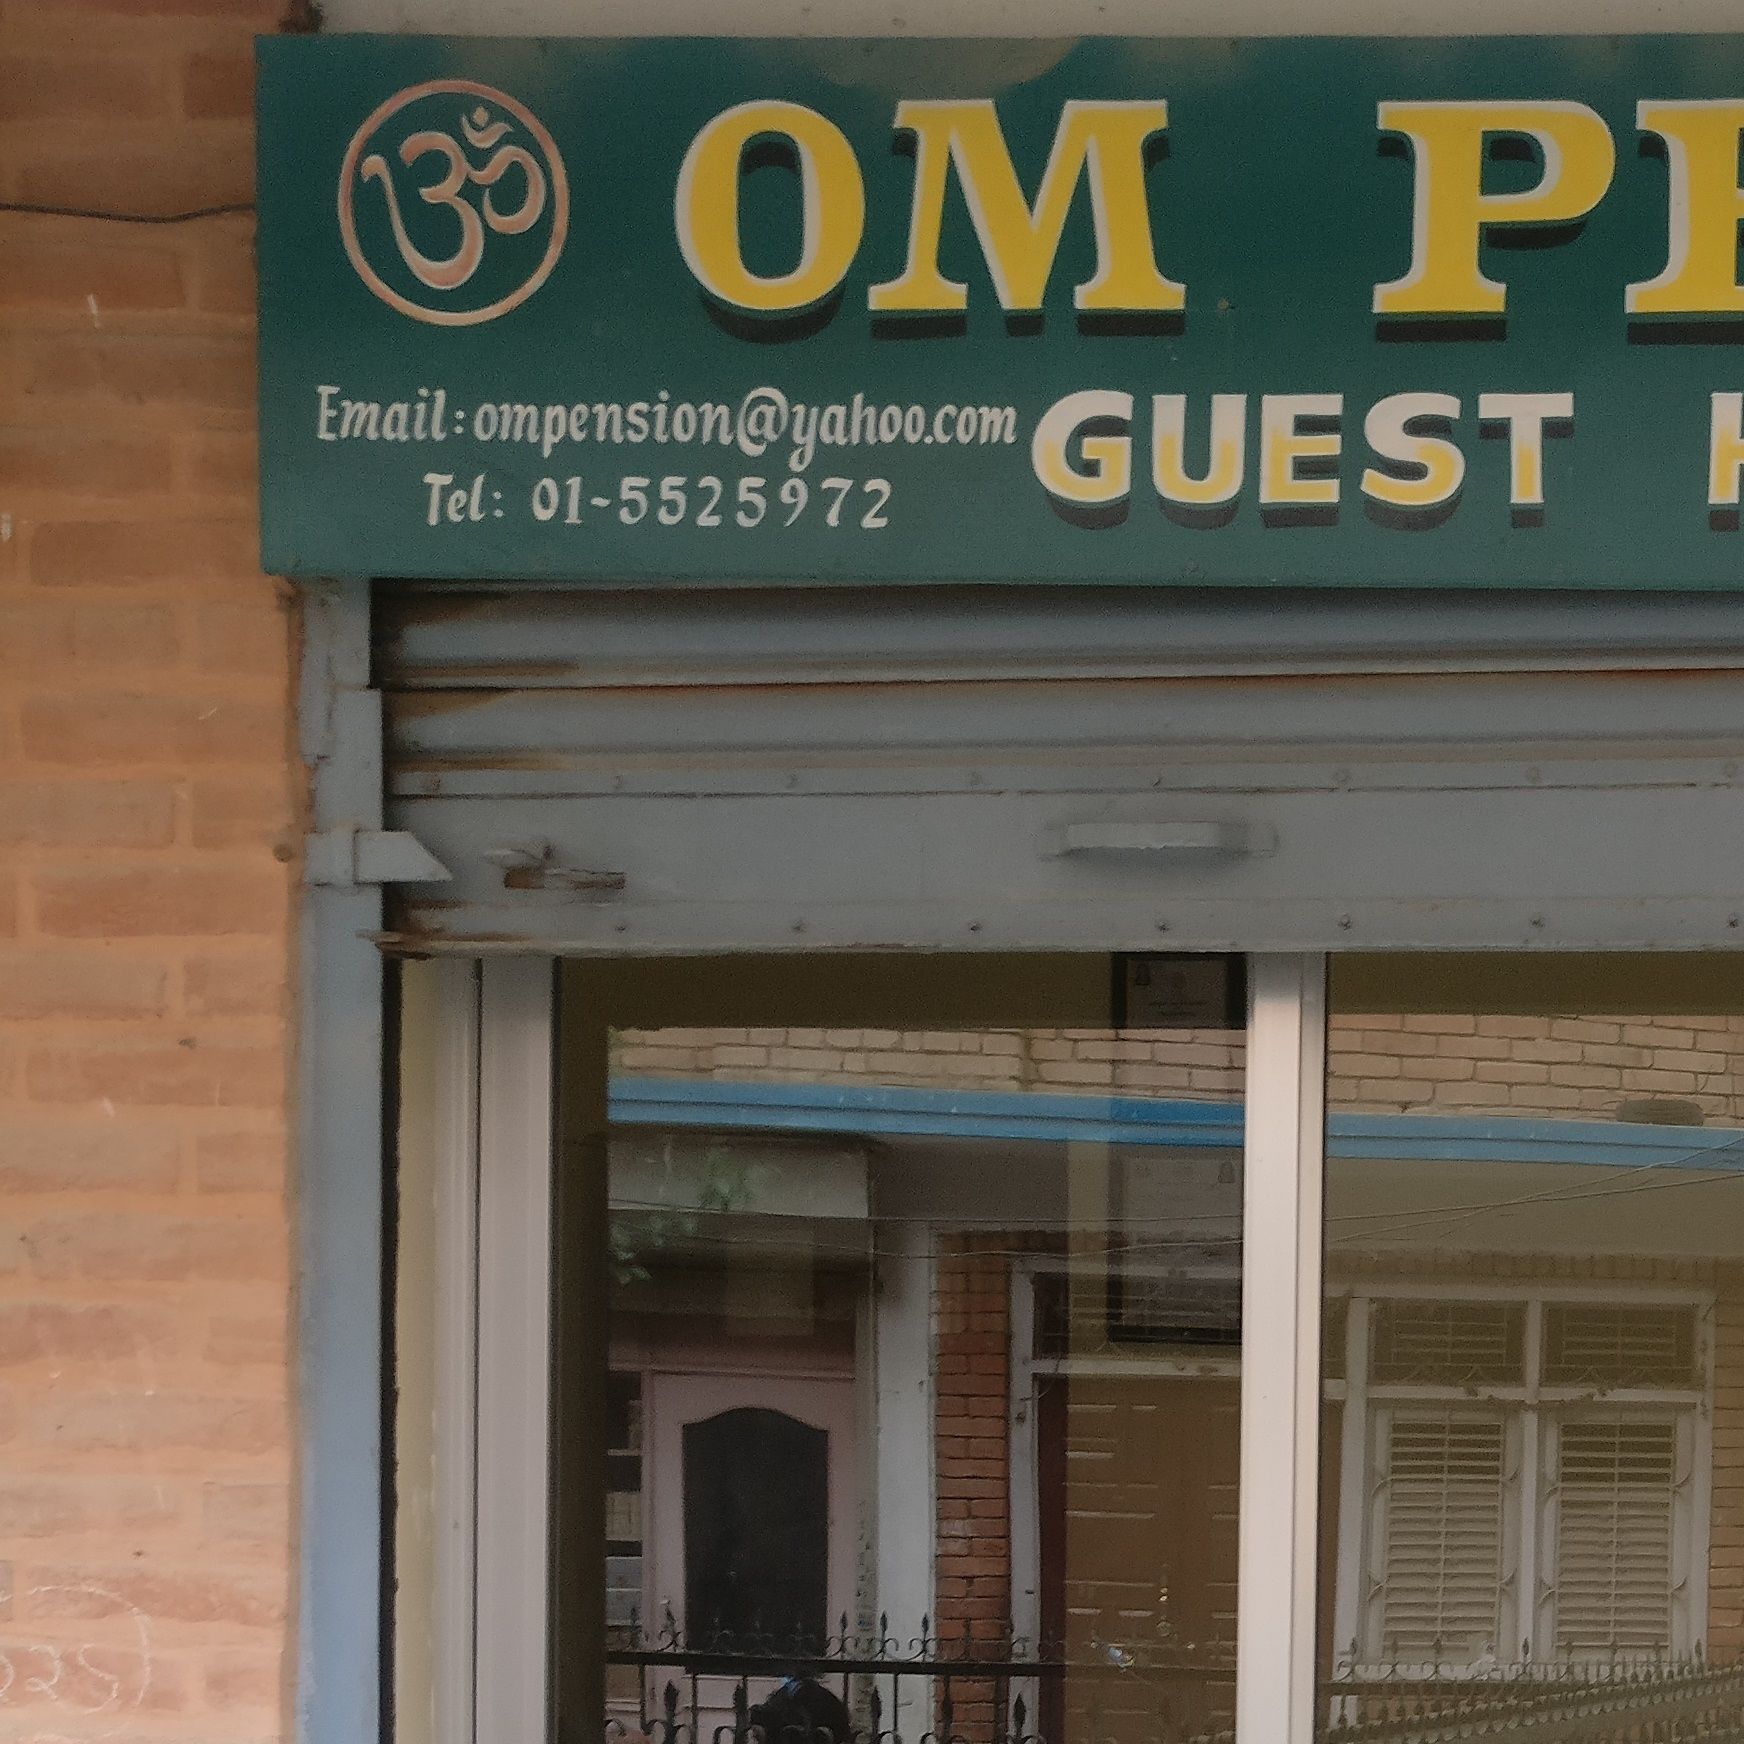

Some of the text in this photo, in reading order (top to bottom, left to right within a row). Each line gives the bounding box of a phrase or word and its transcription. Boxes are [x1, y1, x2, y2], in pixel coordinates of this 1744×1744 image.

[674, 98, 1187, 313] OM
[422, 471, 893, 529] Tel: 01-5525972
[1030, 389, 1576, 508] GUEST
